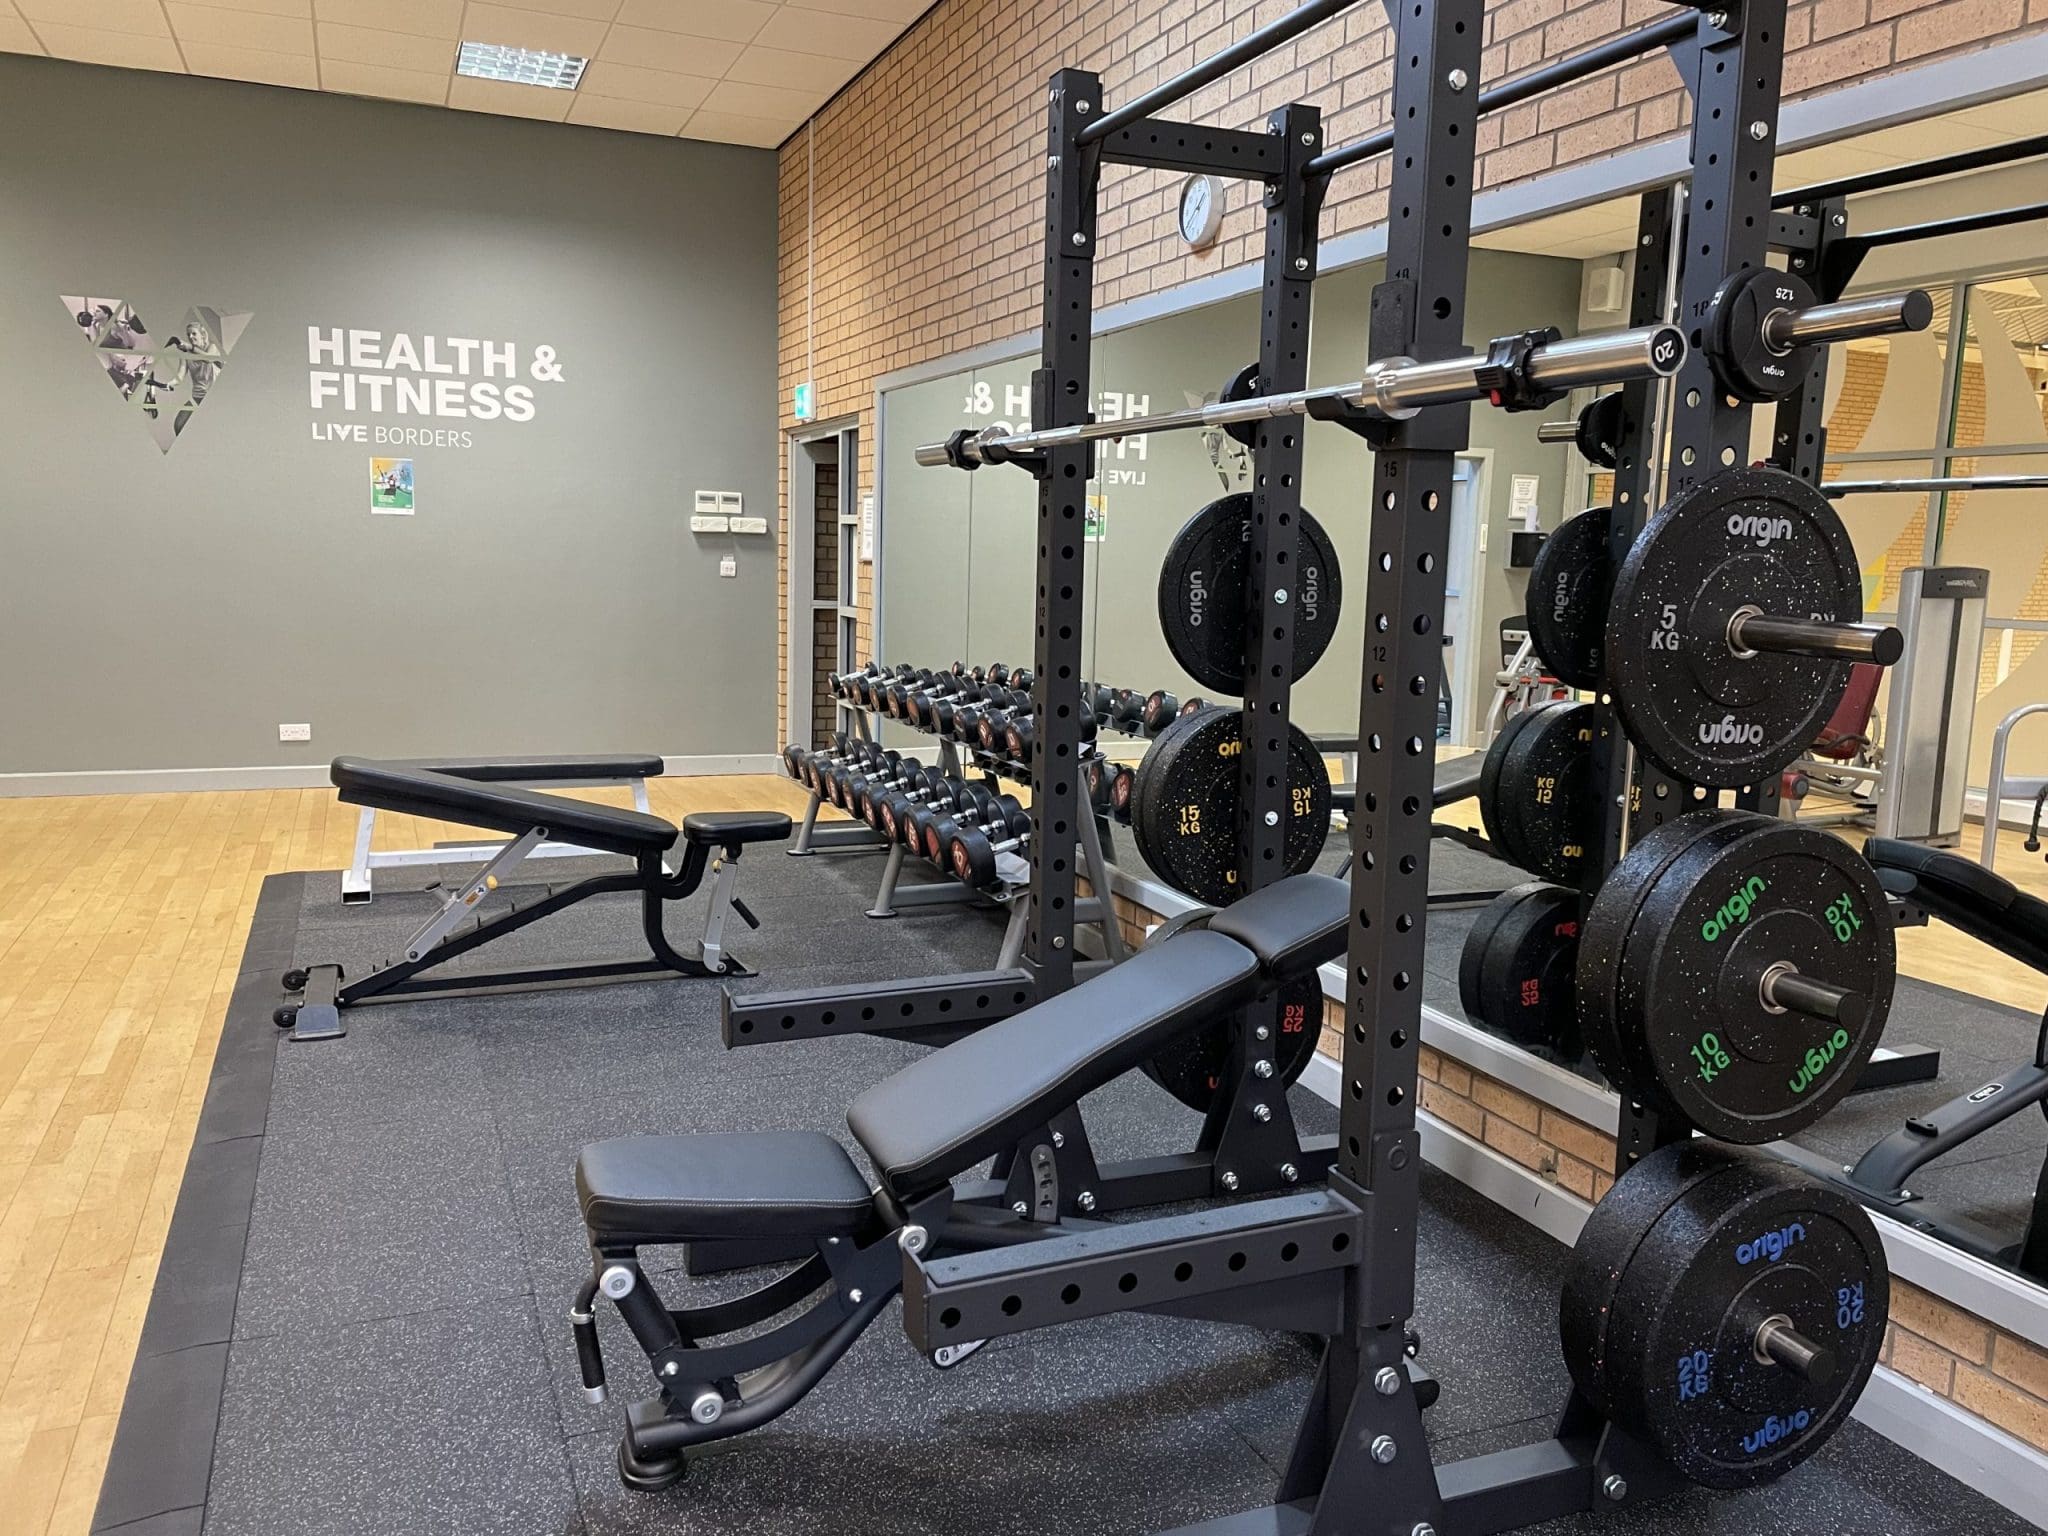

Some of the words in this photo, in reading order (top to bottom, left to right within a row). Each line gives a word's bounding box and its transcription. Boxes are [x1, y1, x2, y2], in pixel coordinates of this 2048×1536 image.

[308, 326, 516, 379] HEALTH
[530, 344, 566, 382] &
[1655, 340, 1675, 363] 20
[1762, 365, 1785, 377] origin
[309, 371, 536, 422] FITNESS
[312, 422, 368, 443] LIVE
[375, 426, 473, 448] BORDERS
[1383, 462, 1398, 478] 15
[1727, 514, 1793, 548] origin
[1189, 570, 1207, 627] origin
[1302, 566, 1318, 621] origin
[1660, 604, 1678, 629] 5
[1650, 630, 1680, 650] KG
[1373, 646, 1386, 662] 12
[1700, 715, 1764, 744] origin
[1292, 786, 1312, 801] KG
[1180, 804, 1201, 822] 15
[1293, 799, 1312, 817] 15
[1180, 822, 1201, 836] KG
[1365, 823, 1373, 840] 9
[1702, 876, 1766, 942] origin
[1824, 892, 1853, 925] KG
[1834, 910, 1862, 943] 10
[1285, 1004, 1304, 1017] KG
[1282, 1017, 1304, 1033] 25
[1690, 1032, 1721, 1065] 10
[1788, 1028, 1850, 1093] origin
[1699, 1050, 1731, 1083] KG
[1735, 1222, 1806, 1265] origin
[1837, 1280, 1864, 1306] KG
[1837, 1302, 1865, 1329] 20
[1677, 1350, 1709, 1382] 20
[1680, 1374, 1709, 1401] KG
[1743, 1410, 1810, 1454] origin
